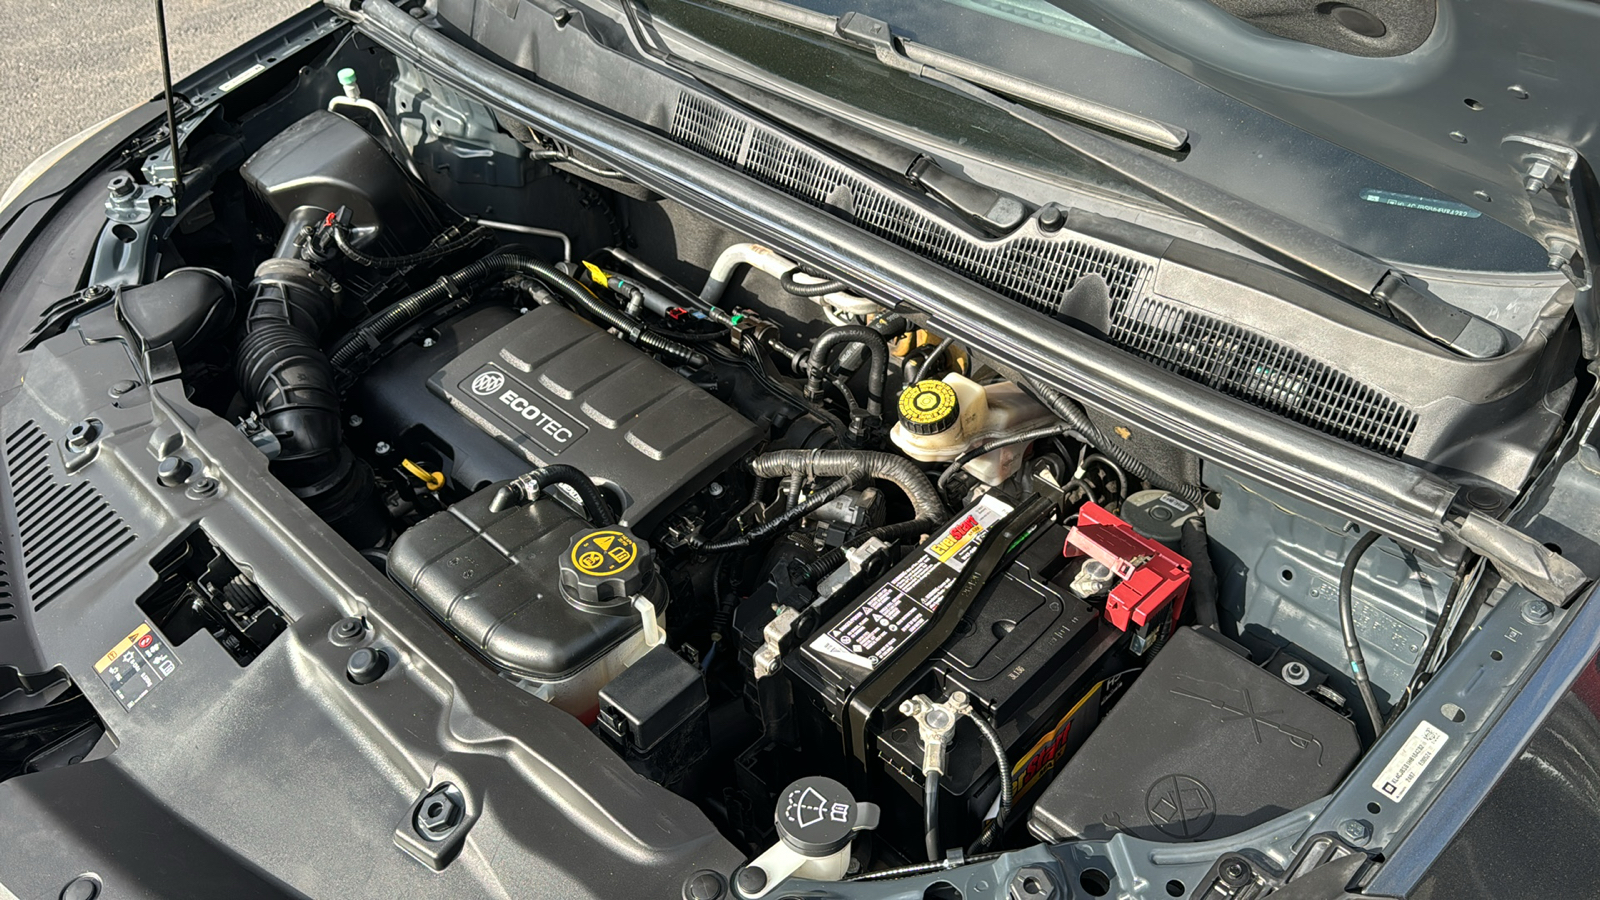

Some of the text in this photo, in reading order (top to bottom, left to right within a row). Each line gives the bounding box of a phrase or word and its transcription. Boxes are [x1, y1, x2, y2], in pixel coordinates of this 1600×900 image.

[499, 390, 573, 443] ECOTEC
[931, 515, 979, 556] EverStart
[1011, 718, 1074, 797] erStart
